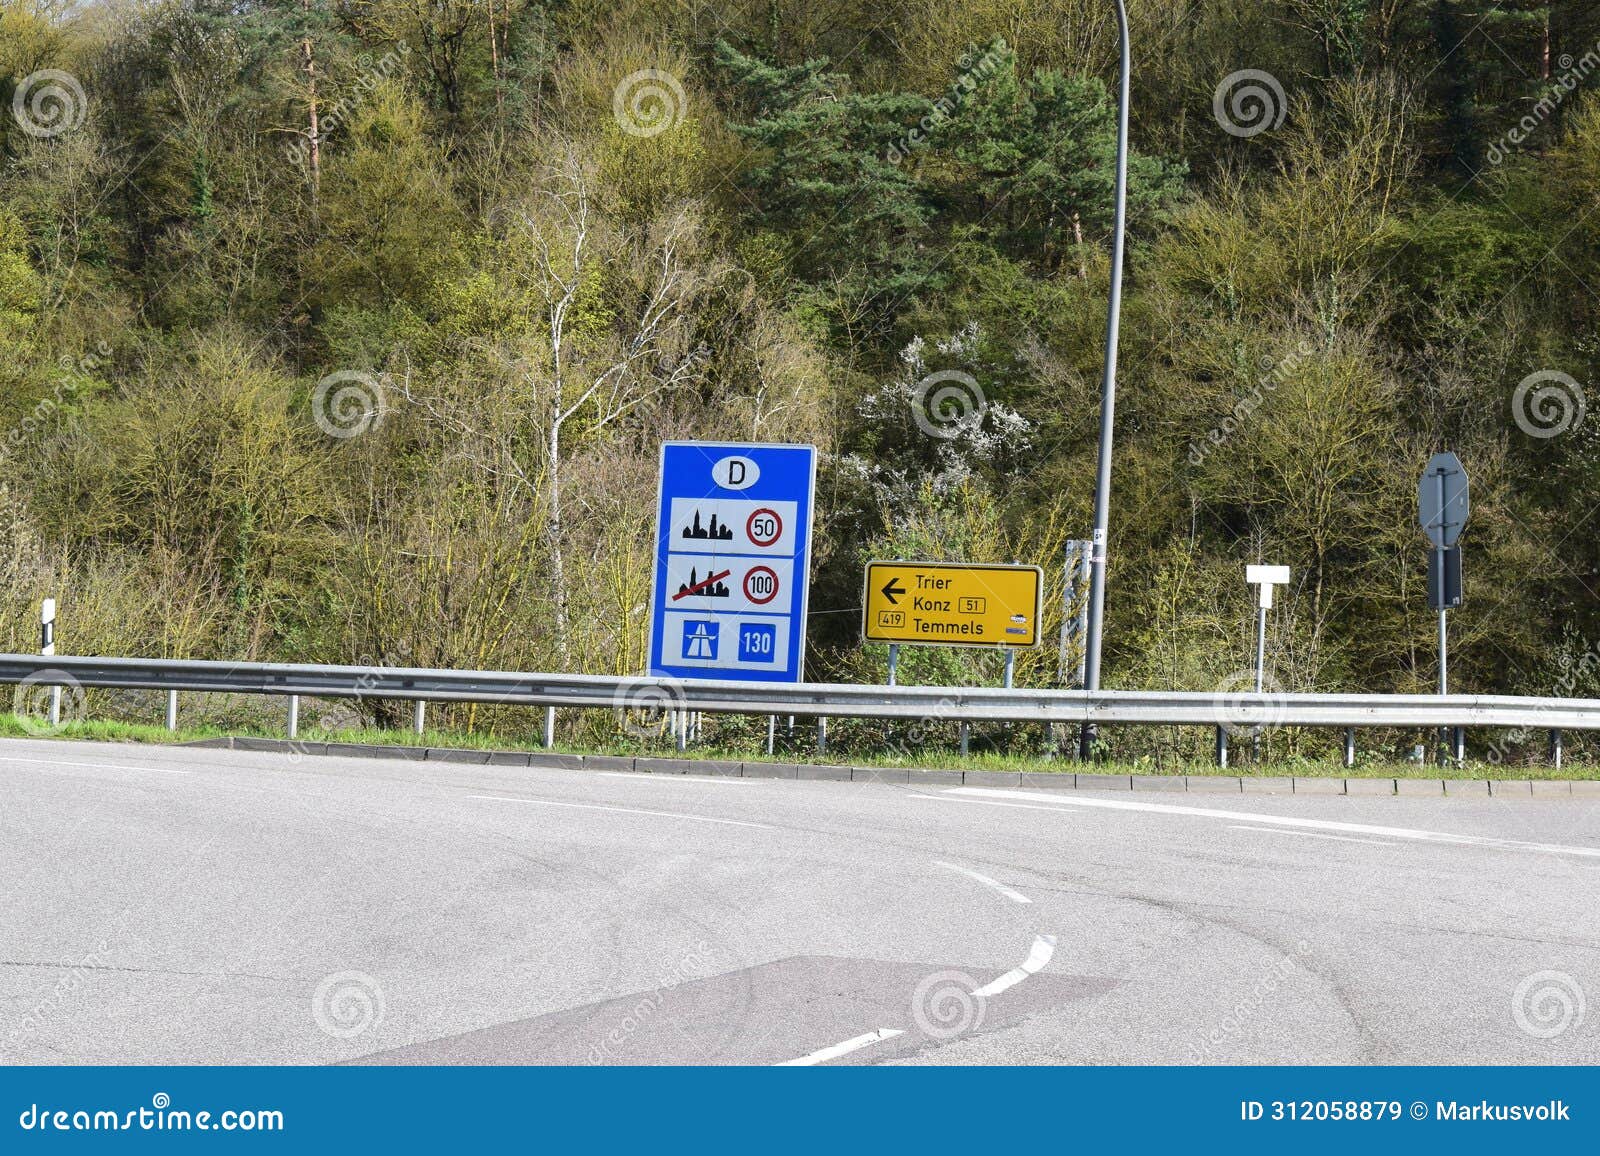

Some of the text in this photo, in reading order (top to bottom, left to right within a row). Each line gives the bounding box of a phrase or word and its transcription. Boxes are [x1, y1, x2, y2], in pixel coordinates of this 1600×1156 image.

[728, 460, 746, 485] D
[754, 519, 774, 537] 50
[750, 576, 772, 594] 100
[915, 574, 953, 590] Trier
[913, 596, 979, 612] Konz 51
[882, 613, 901, 625] 419
[913, 618, 984, 635] Temmels
[744, 632, 771, 654] 130
